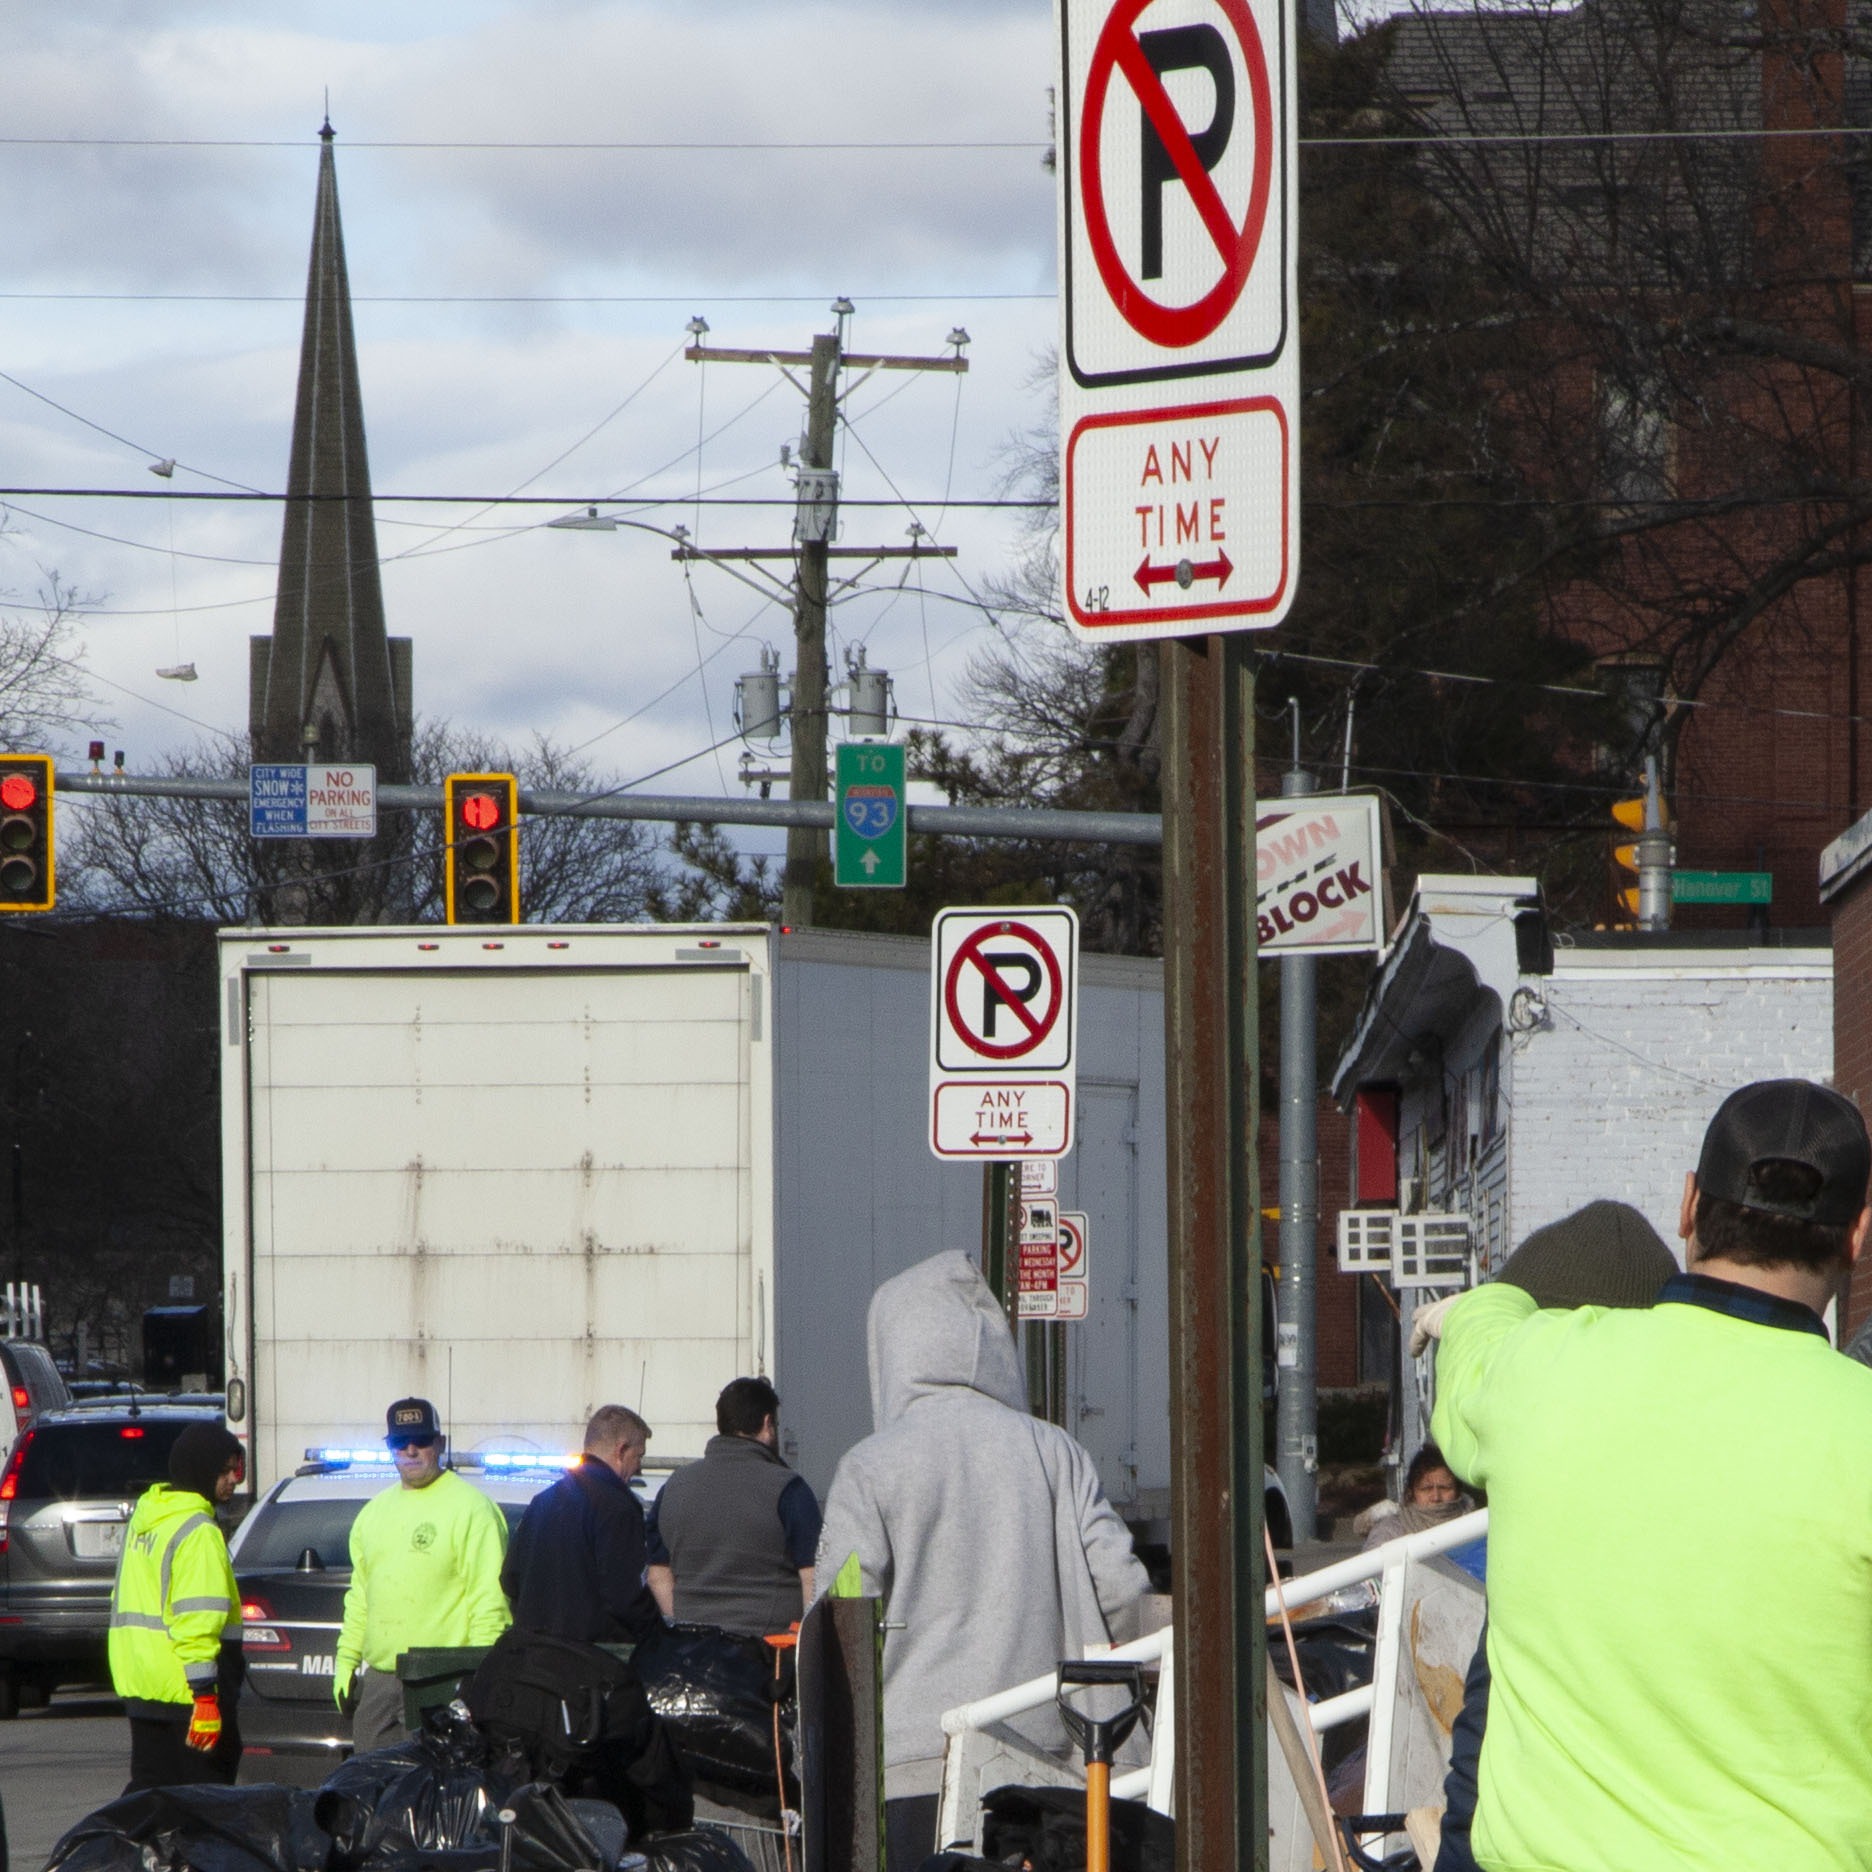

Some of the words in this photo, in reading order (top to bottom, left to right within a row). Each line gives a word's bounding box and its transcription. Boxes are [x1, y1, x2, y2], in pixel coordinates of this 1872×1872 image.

[1141, 437, 1221, 487] ANY
[1135, 498, 1227, 548] TIME
[856, 754, 887, 773] TO
[255, 768, 276, 779] CITY
[279, 767, 304, 779] WIDE
[326, 772, 354, 788] NO
[254, 780, 289, 796] SNOW
[254, 799, 305, 808] EMERGENCY
[309, 790, 371, 806] PARKING
[265, 810, 295, 821] WHEN
[849, 801, 889, 828] 93
[256, 822, 305, 833] FLASHING
[309, 820, 329, 830] CITY
[333, 820, 372, 830] STREETS
[1256, 814, 1341, 880] OWN
[1257, 861, 1372, 945] BLOCK
[980, 1090, 1026, 1109] ANY
[975, 1110, 1029, 1129] TIME
